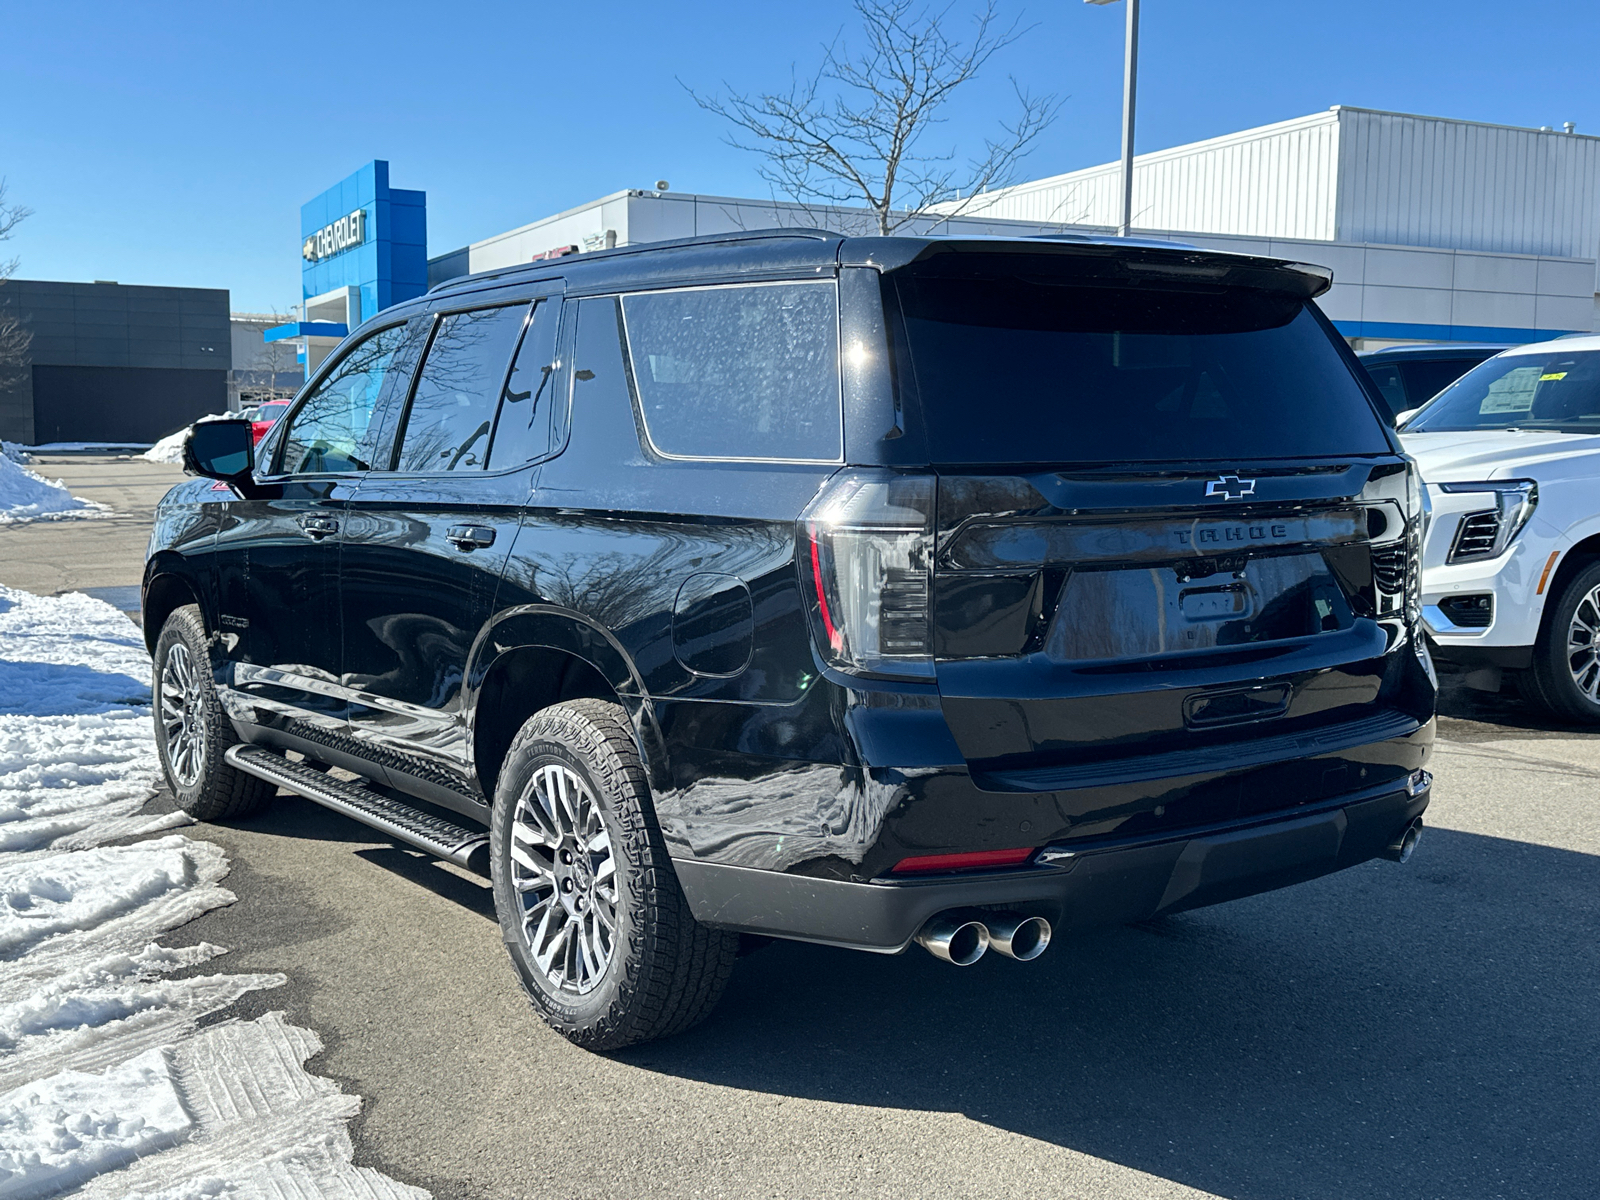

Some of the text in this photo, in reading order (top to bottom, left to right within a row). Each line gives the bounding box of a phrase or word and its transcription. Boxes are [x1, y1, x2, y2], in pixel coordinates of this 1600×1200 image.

[316, 208, 365, 259] CHEVROLET
[1174, 524, 1287, 545] TAHOE
[526, 744, 576, 765] TERRITORY AT
[541, 994, 578, 1016] 275/60R20
